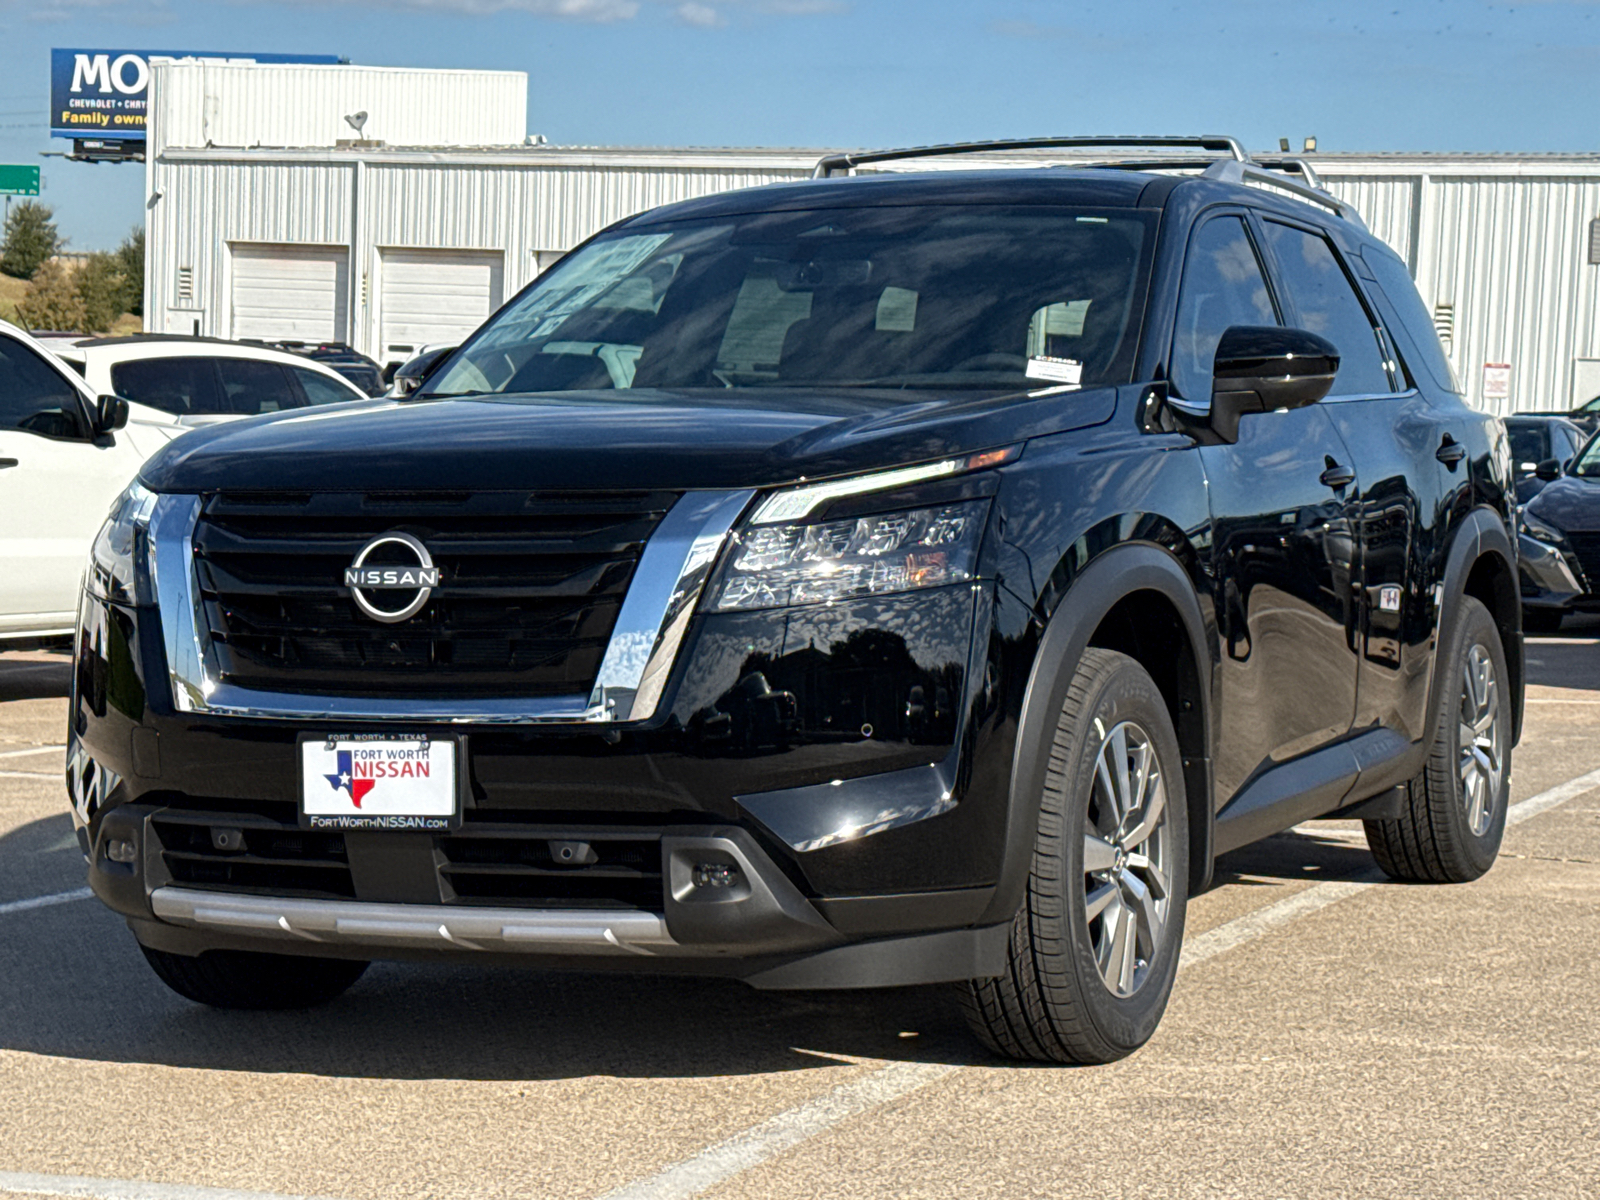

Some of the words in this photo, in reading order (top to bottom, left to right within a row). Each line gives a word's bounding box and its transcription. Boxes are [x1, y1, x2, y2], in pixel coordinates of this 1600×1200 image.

[70, 53, 149, 95] MO
[69, 98, 116, 109] CHEVROLET
[124, 99, 148, 109] CHRY
[62, 111, 110, 127] Family
[345, 570, 436, 585] NISSAN
[354, 750, 383, 760] FORT
[386, 749, 430, 760] WORTH
[354, 761, 430, 778] NISSAN
